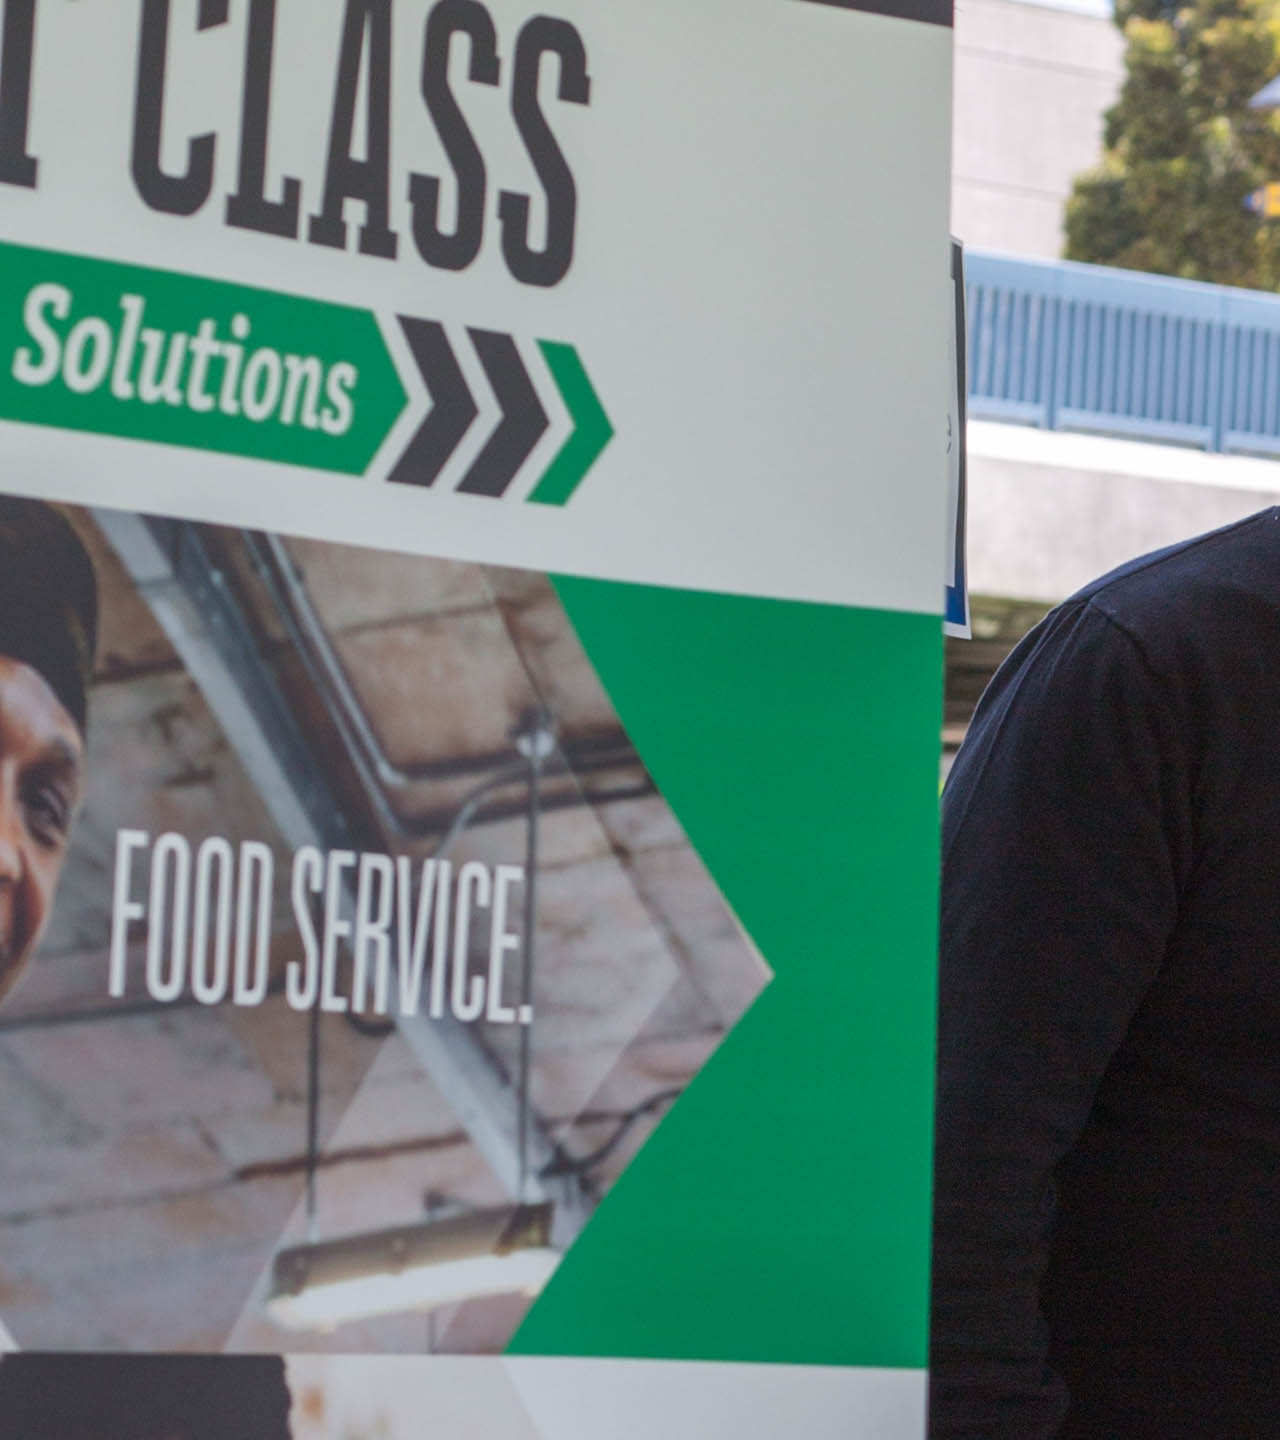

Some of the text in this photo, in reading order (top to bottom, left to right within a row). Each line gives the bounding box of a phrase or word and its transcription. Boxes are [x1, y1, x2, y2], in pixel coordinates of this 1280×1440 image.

[12, 282, 359, 436] Solutions
[109, 828, 534, 1025] FOOD SERVICE.
